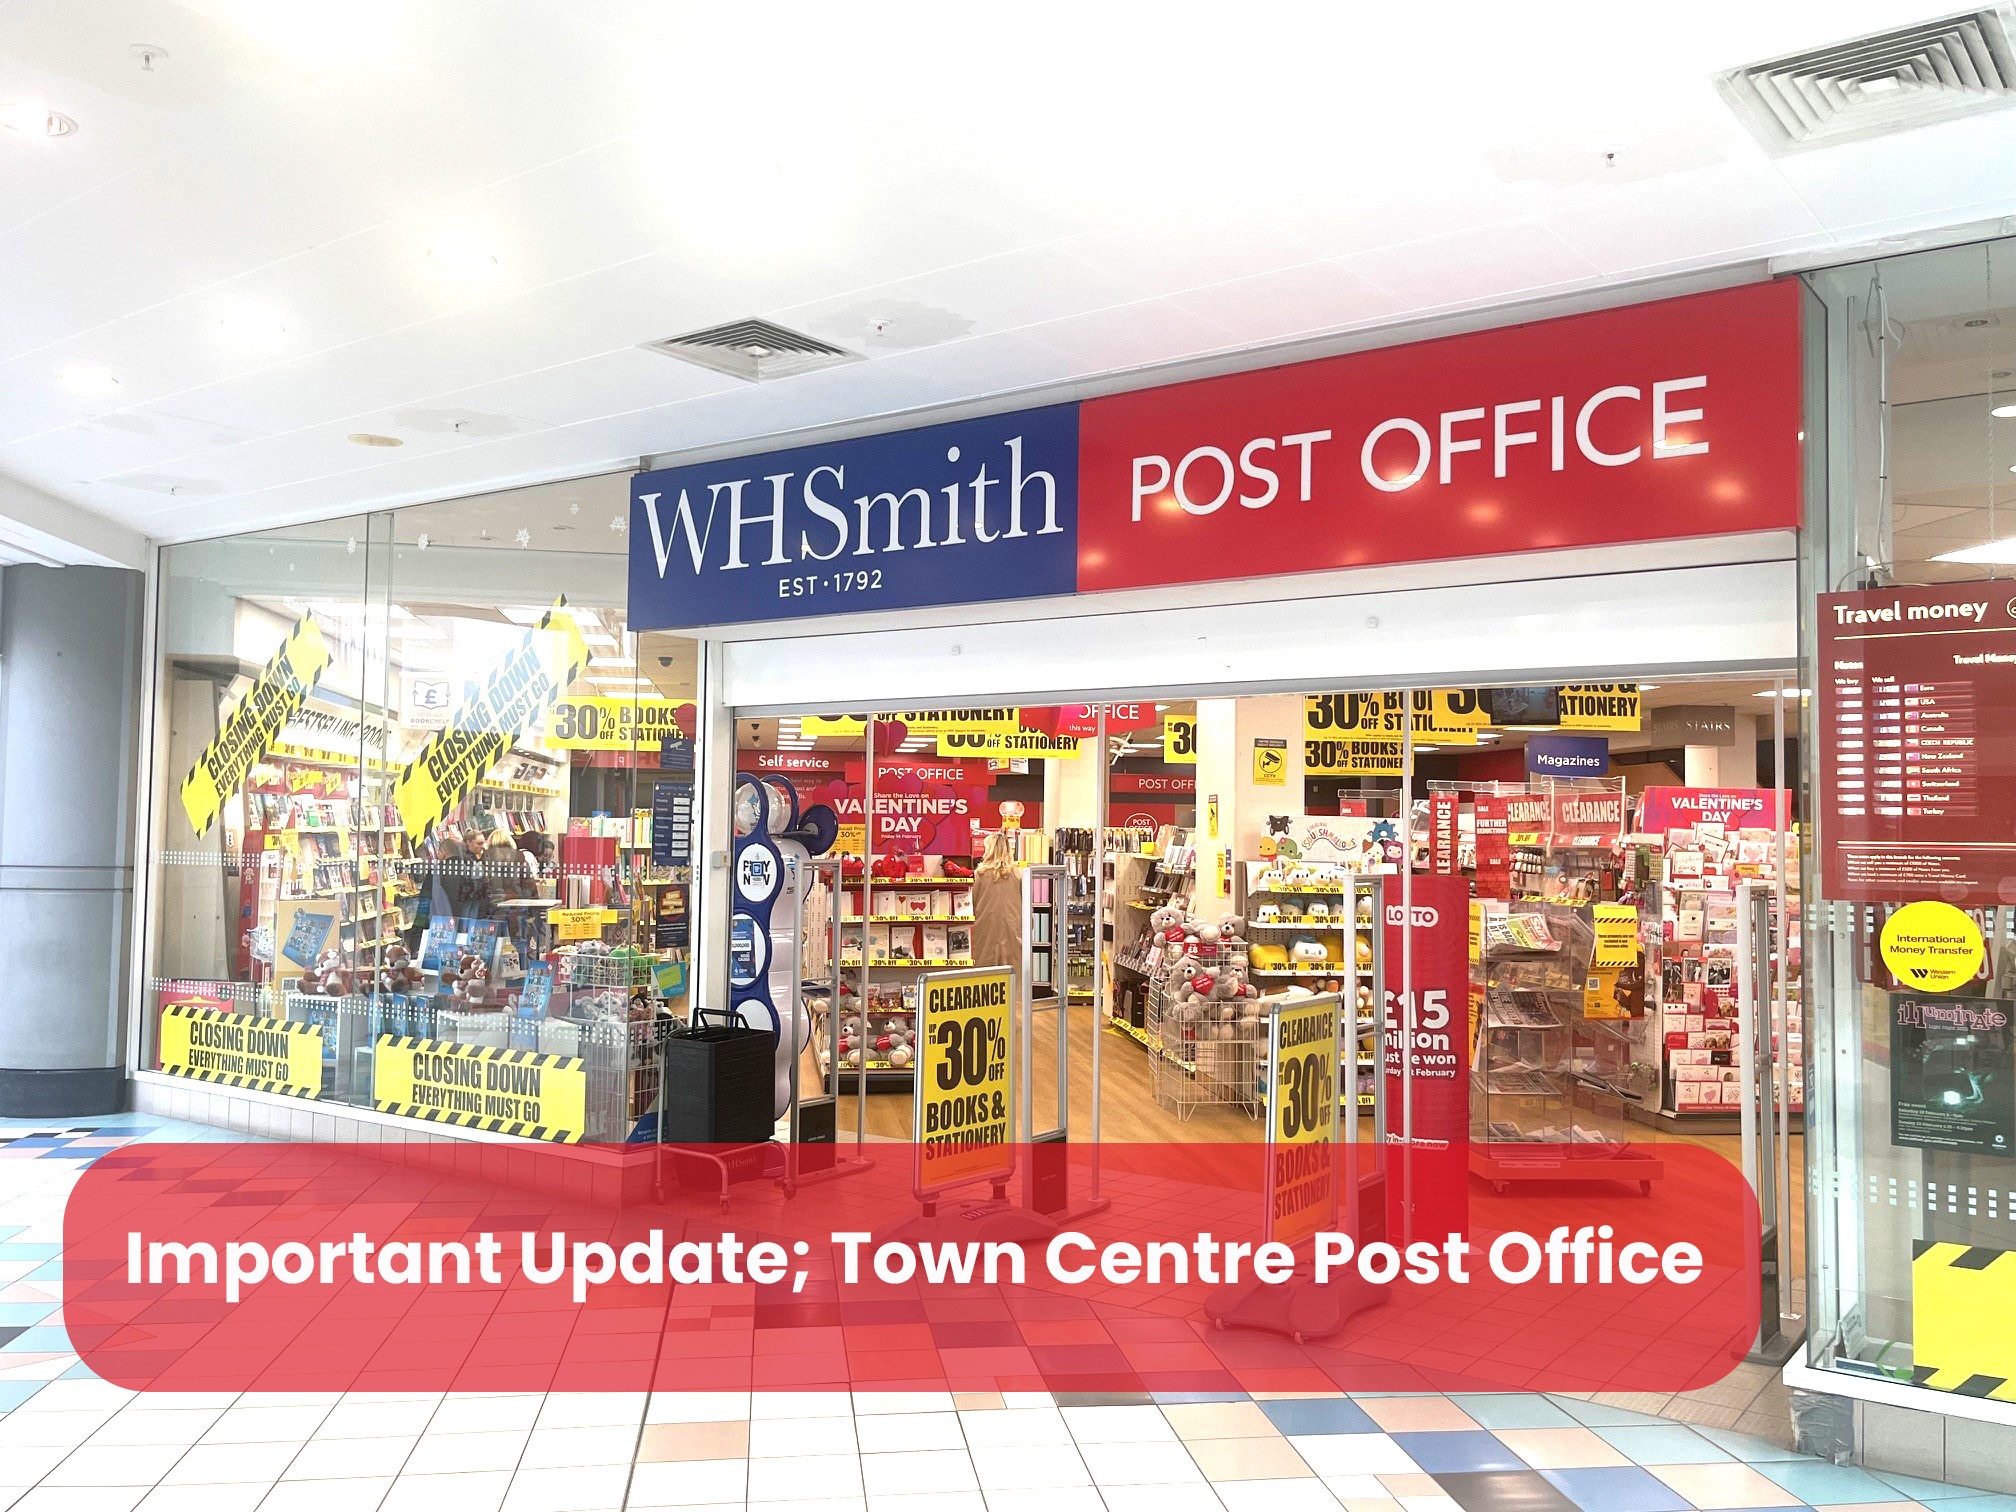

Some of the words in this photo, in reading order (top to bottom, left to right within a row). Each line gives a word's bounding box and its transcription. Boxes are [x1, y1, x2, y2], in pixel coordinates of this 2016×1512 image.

[1131, 429, 1332, 522] POST
[1360, 375, 1710, 492] OFFICE
[638, 435, 1064, 579] WHSmith
[1833, 600, 1901, 625] Travel
[1907, 600, 1989, 623] money
[1953, 653, 1984, 665] Travel
[1559, 695, 1639, 717] ATIONERY
[207, 706, 258, 781] CLOSING
[252, 654, 294, 717] DOWN
[427, 701, 492, 783] CLOSING
[487, 646, 541, 709] DOWN
[555, 703, 616, 740] 30%
[1069, 724, 1081, 732] this
[1082, 725, 1096, 734] way
[1361, 718, 1378, 730] OFF
[1685, 720, 1732, 732] STAIRS
[214, 728, 265, 799] EVERYTHING
[261, 693, 290, 735] MUST
[286, 676, 301, 702] GO
[436, 725, 502, 804] EVERYTHING
[498, 690, 533, 735] MUST
[533, 672, 550, 701] GO
[599, 730, 614, 740] OFF
[987, 736, 1001, 749] OFF
[1005, 734, 1079, 751] STATIONERY
[1304, 740, 1349, 768] 30%
[1351, 740, 1398, 756] BOOKS
[758, 755, 784, 768] Self
[786, 756, 830, 769] service
[1337, 759, 1348, 768] OFF
[1536, 753, 1601, 769] Magazines
[916, 767, 964, 780] OFFICE
[1138, 778, 1169, 789] POST
[1477, 805, 1489, 813] SALE
[1507, 800, 1551, 823] CLEARANCE
[1561, 800, 1620, 824] CLEARANCE
[1672, 797, 1763, 811] VALENTINE'S
[880, 816, 922, 833] DAY
[1132, 818, 1151, 826] POST
[1476, 818, 1508, 828] FURTHER
[1702, 811, 1731, 823] DAY
[1435, 800, 1452, 875] LEARANCE
[1476, 827, 1508, 835] REDUCTIONS
[1571, 835, 1602, 846] CLEARANCE
[1277, 915, 1292, 924] 30%
[1292, 915, 1303, 924] OFF
[1314, 915, 1330, 924] 30%
[1330, 915, 1340, 924] OFF
[1388, 909, 1435, 922] LOTO
[1896, 934, 1966, 944] International
[1889, 945, 1926, 956] Money
[1927, 945, 1974, 955] Transfer
[1271, 962, 1287, 971] 30%
[1287, 962, 1298, 971] OFF
[1310, 962, 1325, 971] 30%
[1326, 962, 1335, 971] OFF
[929, 981, 1006, 1013] CLEARANCE
[928, 1023, 937, 1034] UP
[1279, 1011, 1333, 1050] CLEARANCE
[189, 1020, 244, 1053] CLOSING
[247, 1028, 289, 1060] DOWN
[928, 1034, 937, 1045] TO
[936, 1016, 1006, 1091] 30%
[1385, 1053, 1401, 1064] ust
[1423, 1055, 1457, 1065] won
[188, 1048, 244, 1075] EVERYTHING
[245, 1057, 273, 1078] MUST
[275, 1063, 289, 1082] GO
[988, 1061, 1005, 1082] OFF
[1416, 1068, 1456, 1078] February
[413, 1052, 482, 1090] CLOSING
[486, 1062, 541, 1098] DOWN
[1282, 1051, 1332, 1139] 30%
[412, 1083, 482, 1112] EVERYTHING
[484, 1095, 521, 1120] MUST
[523, 1100, 541, 1124] GO
[926, 1092, 989, 1134] BOOKS
[991, 1089, 1006, 1119] &
[1319, 1103, 1331, 1128] OFF
[925, 1121, 1007, 1161] STATIONERY
[1275, 1141, 1319, 1189] BOOKS
[1320, 1136, 1331, 1170] &
[1274, 1171, 1331, 1221] STATIONERY
